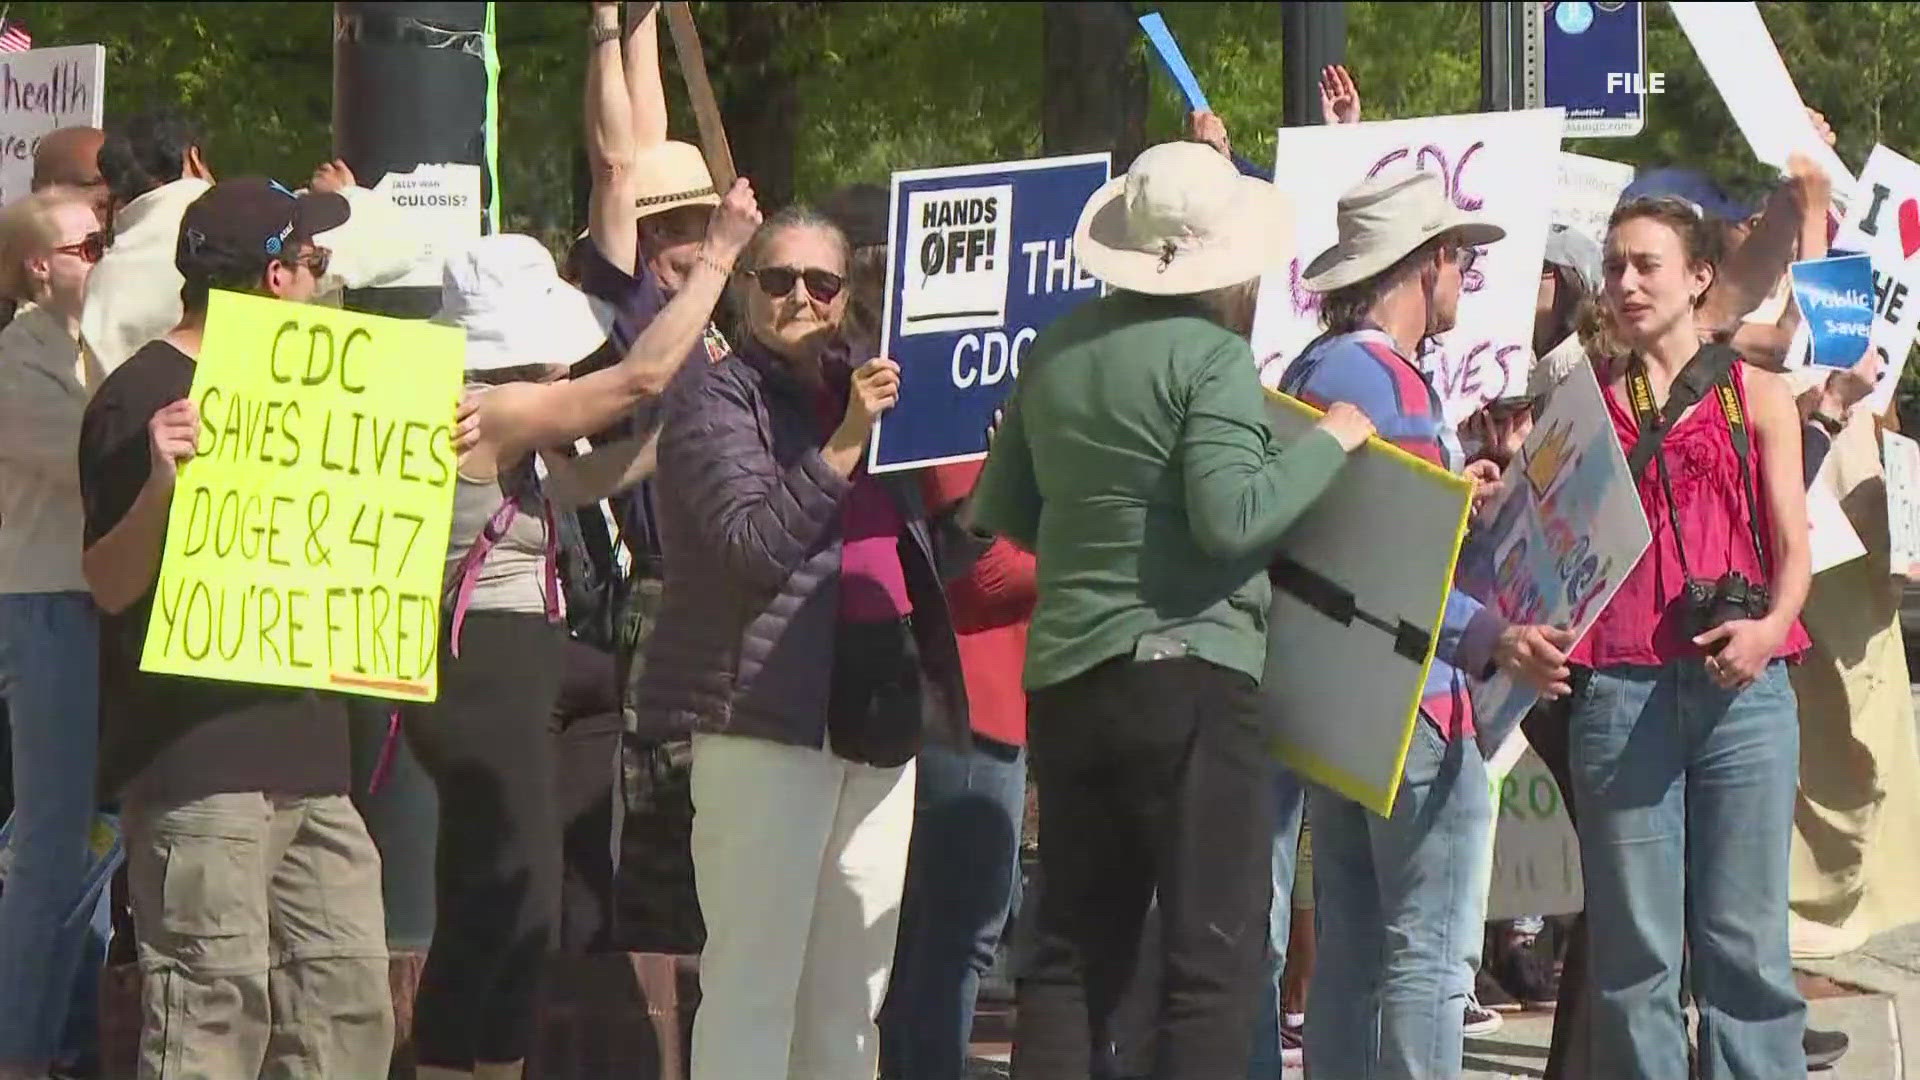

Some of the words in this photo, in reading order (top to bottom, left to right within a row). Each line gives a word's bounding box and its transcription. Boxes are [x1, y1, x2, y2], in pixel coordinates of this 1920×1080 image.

[391, 194, 468, 207] CULOSIS?
[923, 197, 997, 229] HANDS
[1859, 183, 1890, 236] I
[1872, 269, 1909, 324] HE
[271, 320, 372, 394] CDC
[196, 386, 302, 467] SAVES
[321, 409, 452, 488] LIVES
[183, 486, 295, 566] DOGE
[305, 489, 332, 567] &
[349, 503, 424, 578] 47
[161, 575, 313, 668] YOU'RE
[326, 585, 437, 681] FIRED
[1488, 774, 1558, 819] RO
